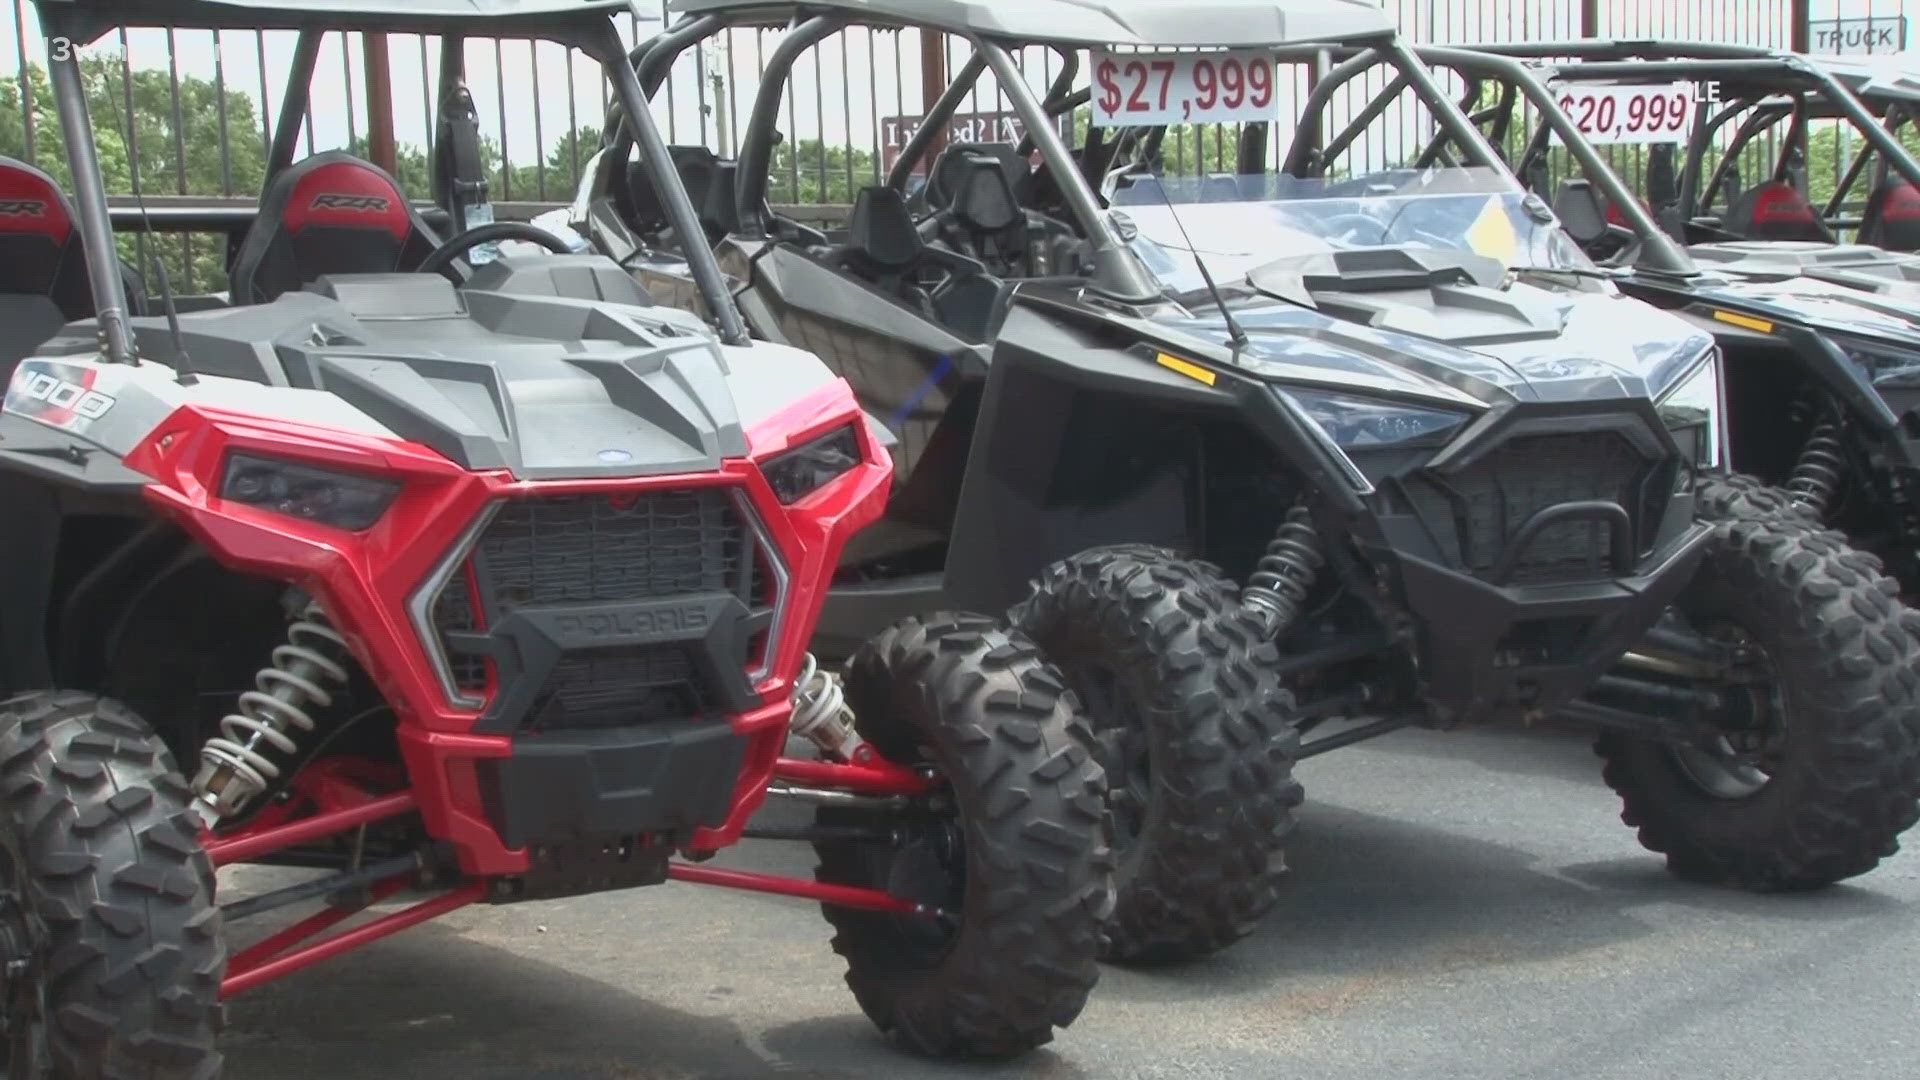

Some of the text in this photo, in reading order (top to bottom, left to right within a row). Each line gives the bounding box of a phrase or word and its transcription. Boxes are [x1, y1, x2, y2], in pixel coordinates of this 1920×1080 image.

[1816, 27, 1893, 49] TRUCK
[1096, 57, 1273, 120] $27,999
[1559, 93, 1688, 140] $20,999
[0, 199, 47, 217] ZR
[308, 193, 388, 212] RZR
[25, 370, 117, 420] 1000
[554, 605, 710, 636] POLARIS
